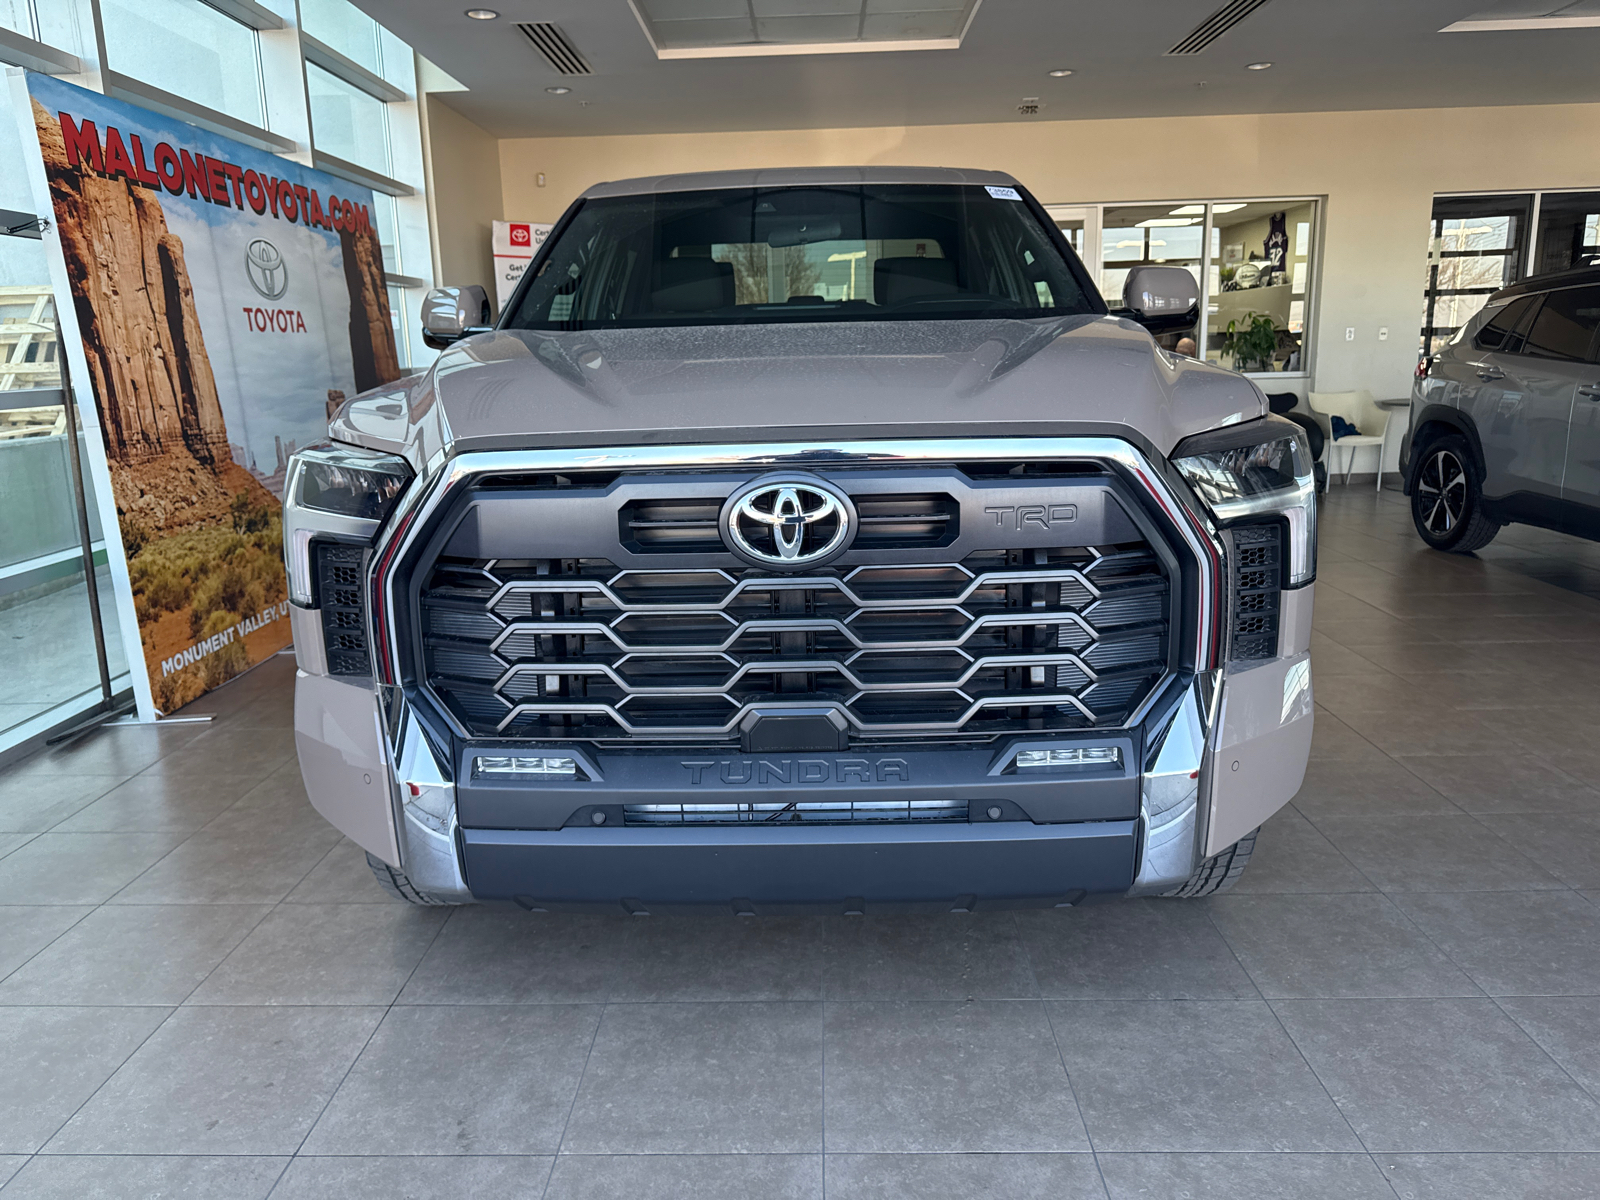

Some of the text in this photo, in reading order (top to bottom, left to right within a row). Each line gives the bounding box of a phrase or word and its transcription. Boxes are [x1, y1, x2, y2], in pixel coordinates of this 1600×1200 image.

[58, 111, 373, 235] MALONETOYOTA.COM
[243, 307, 307, 333] TOYOTA
[985, 503, 1078, 531] TRD
[161, 626, 235, 678] MONUMENT
[236, 606, 279, 637] VALLEY,
[681, 758, 910, 785] TUNDRA
